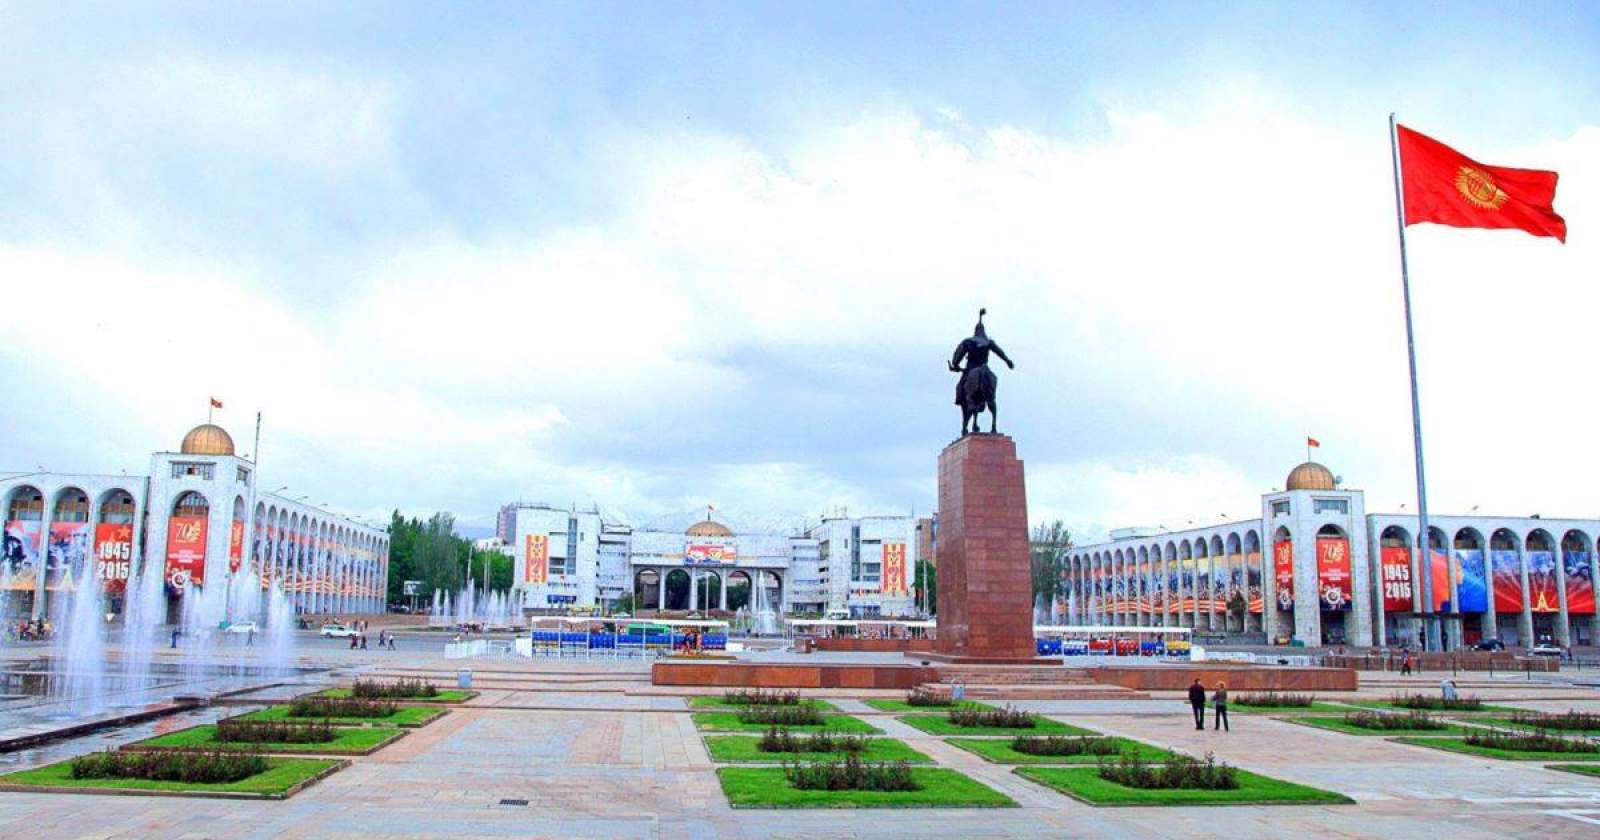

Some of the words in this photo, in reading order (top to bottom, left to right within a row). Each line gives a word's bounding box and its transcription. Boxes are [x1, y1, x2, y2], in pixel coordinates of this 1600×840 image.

[99, 541, 130, 560] 1945
[97, 561, 129, 580] 2015
[1383, 564, 1409, 581] 1945
[1385, 582, 1411, 598] 2015
